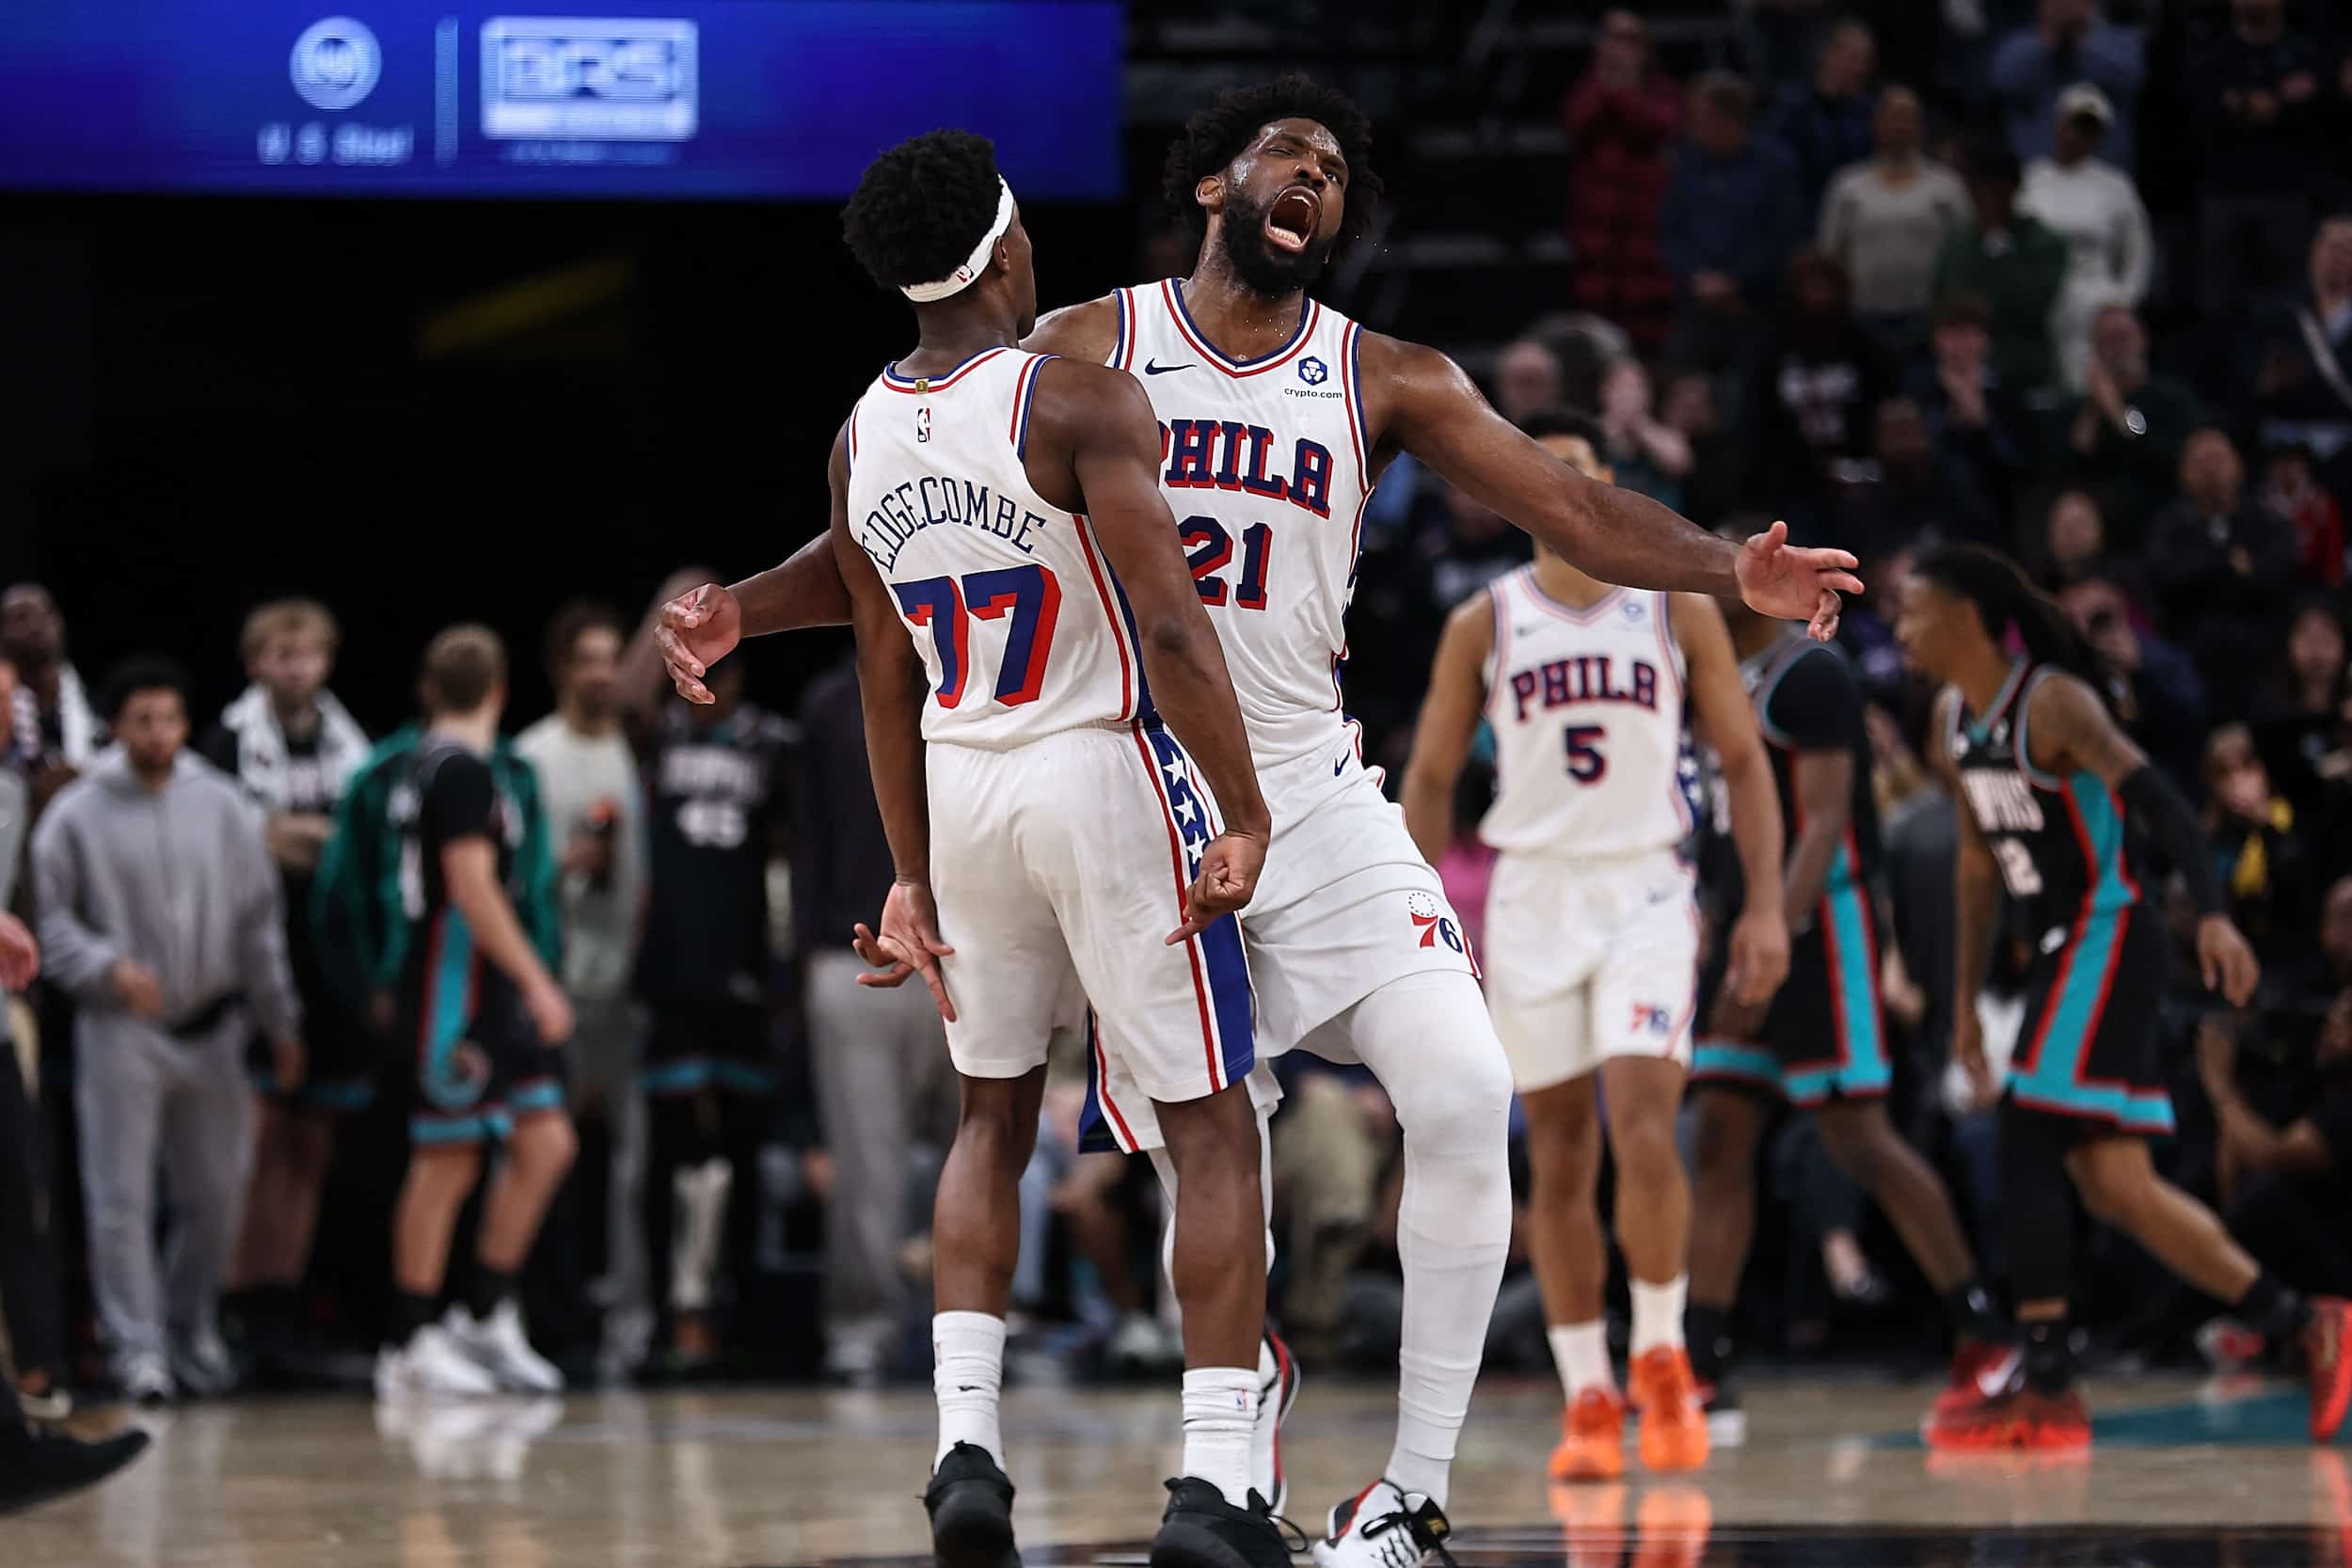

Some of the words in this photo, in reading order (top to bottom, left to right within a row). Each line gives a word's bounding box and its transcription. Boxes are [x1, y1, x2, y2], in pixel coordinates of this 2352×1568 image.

[1284, 388, 1343, 399] crypto.com
[862, 476, 1046, 574] EDGECOMBE
[1177, 515, 1273, 611] 21
[890, 563, 1062, 710] 77
[1510, 656, 1663, 722] PHILA
[1565, 725, 1608, 784] 5
[1410, 911, 1464, 954] 76
